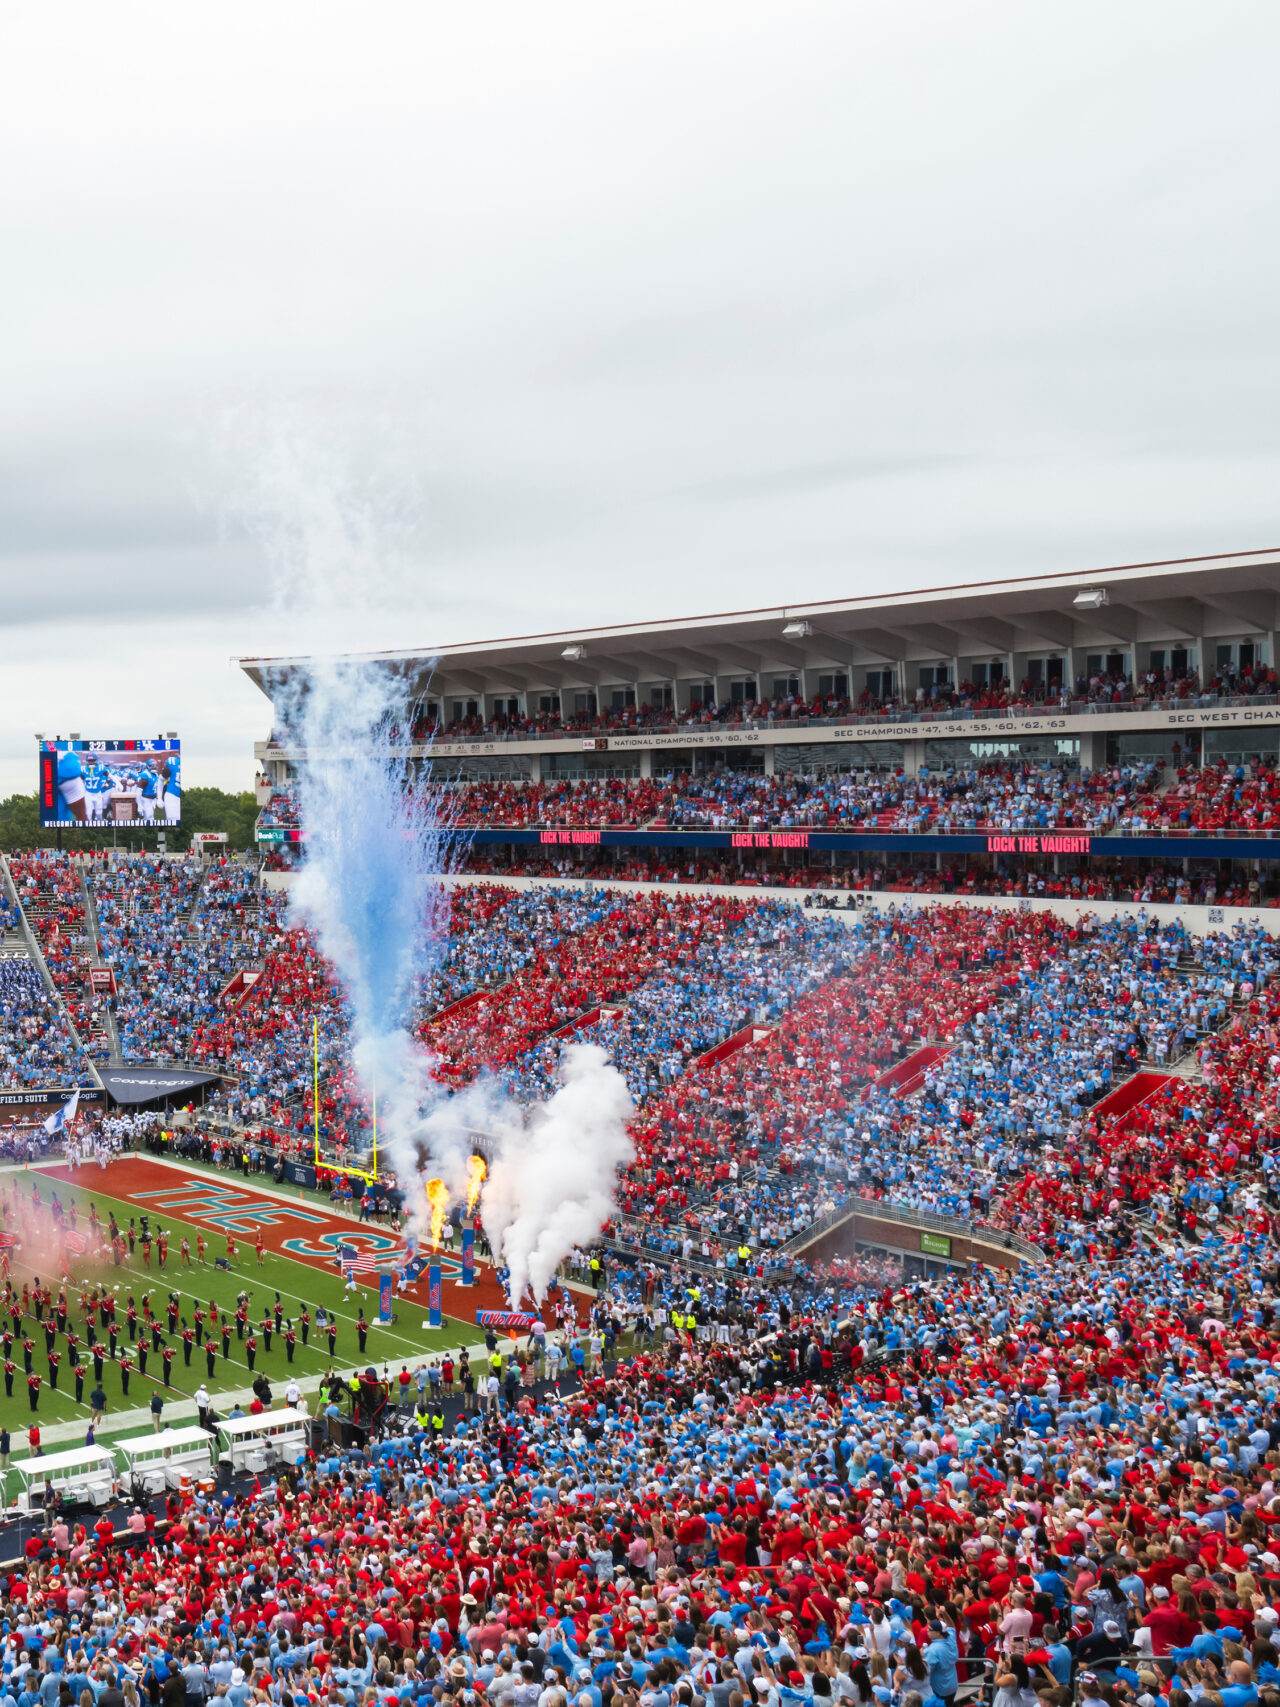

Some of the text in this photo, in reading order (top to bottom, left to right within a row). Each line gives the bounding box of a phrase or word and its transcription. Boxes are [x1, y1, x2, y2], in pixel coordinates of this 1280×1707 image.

[1168, 714, 1195, 723] SEC
[1200, 712, 1239, 721] WEST
[834, 729, 854, 737] SEC
[856, 727, 918, 736] CHAMPIONS
[89, 741, 106, 751] 3:23
[596, 740, 607, 749] 25
[655, 736, 704, 745] CHAMPIONS
[44, 820, 73, 832] WELCOME
[75, 820, 83, 832] TO
[149, 820, 177, 831] STADIUM
[540, 831, 601, 844] LOCK THE VAUGHT!
[732, 833, 808, 848] LOCK THE VAUGHT!
[988, 836, 1090, 853] LOCK THE VAUGHT!
[110, 1077, 194, 1087] CoreLogic
[0, 1094, 48, 1104] FIELD SUITE
[127, 1180, 331, 1234] THE
[64, 1230, 86, 1253] S
[380, 1286, 390, 1313] Ole Miss
[430, 1283, 440, 1310] Ole Miss
[480, 1312, 505, 1325] Ole
